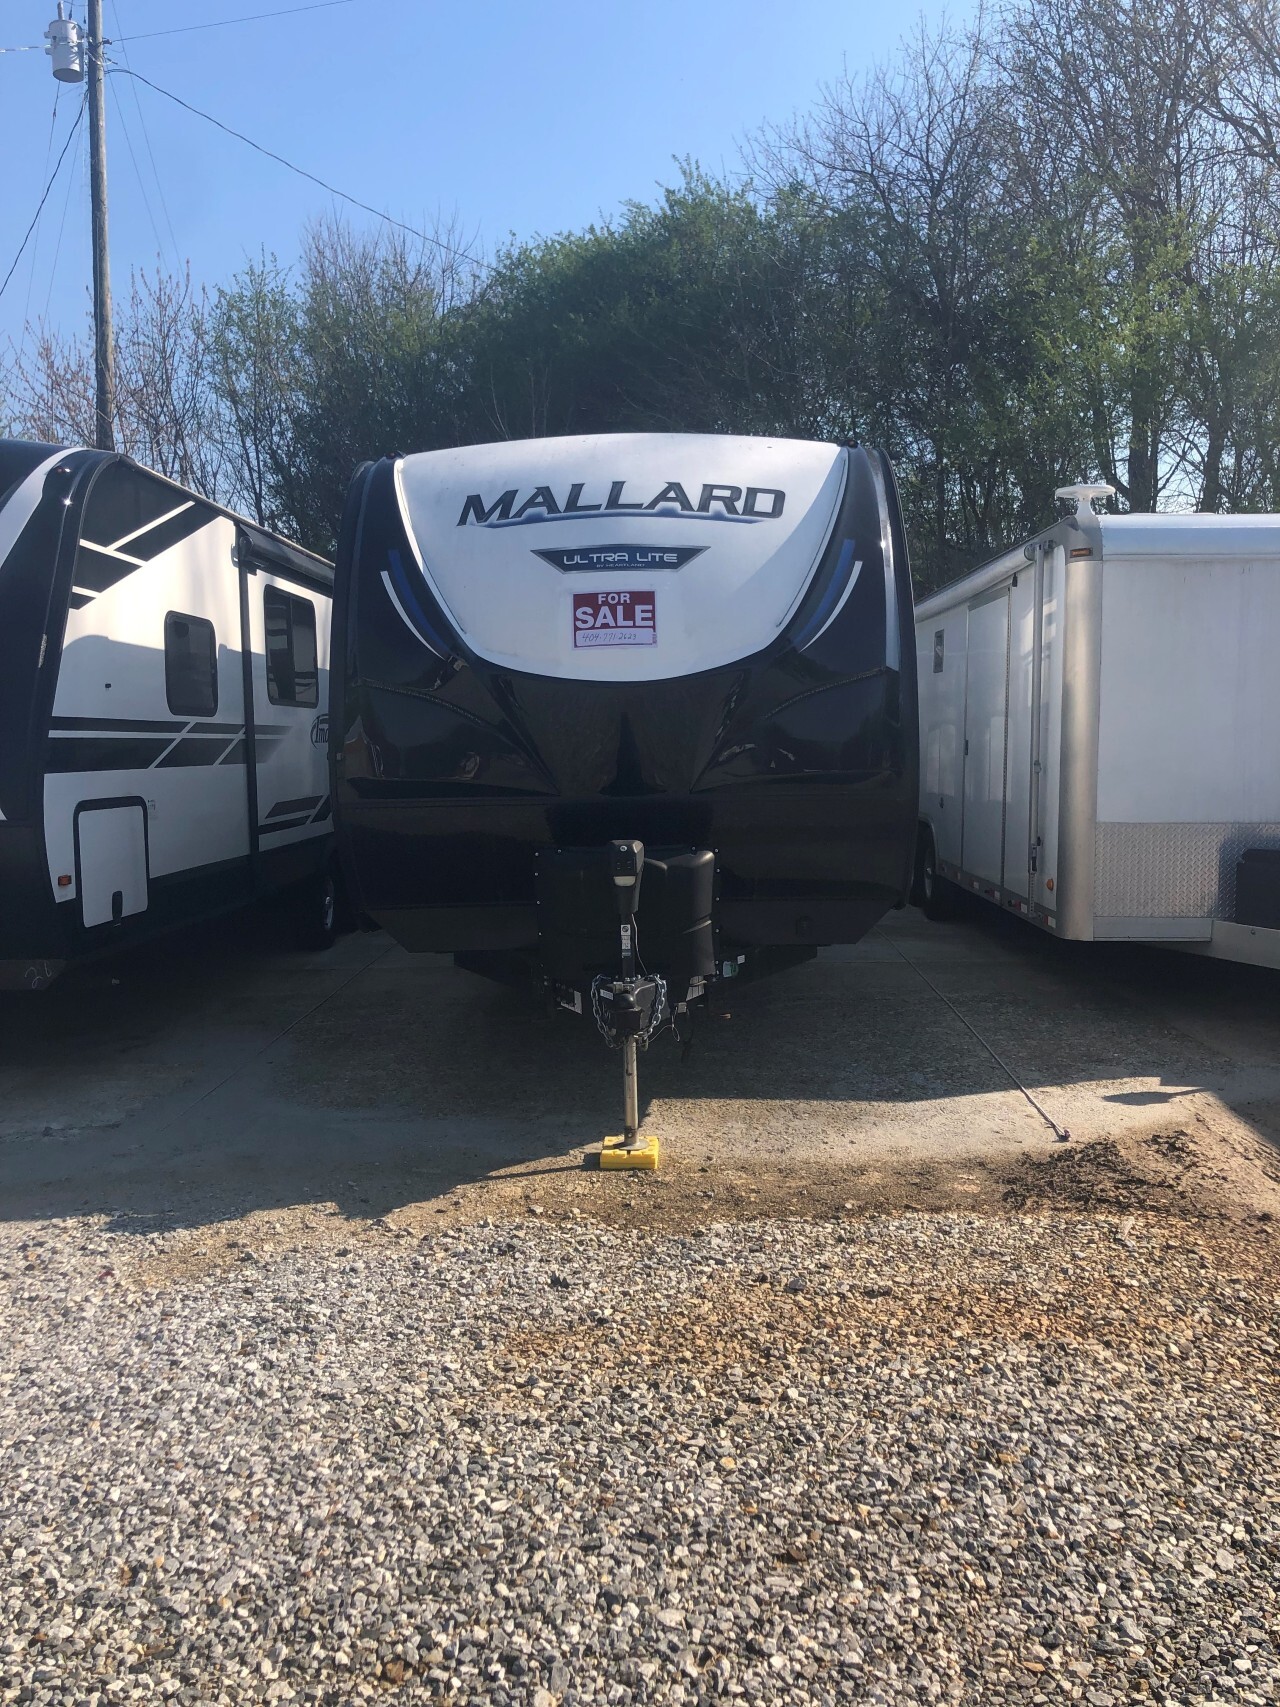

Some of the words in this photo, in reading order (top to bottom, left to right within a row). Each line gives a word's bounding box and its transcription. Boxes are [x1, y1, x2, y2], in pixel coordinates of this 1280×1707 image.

[456, 480, 786, 527] MALLARD
[563, 552, 629, 565] ULTRA
[636, 552, 679, 563] LITE
[597, 592, 631, 605] FOR
[575, 605, 654, 629] SALE
